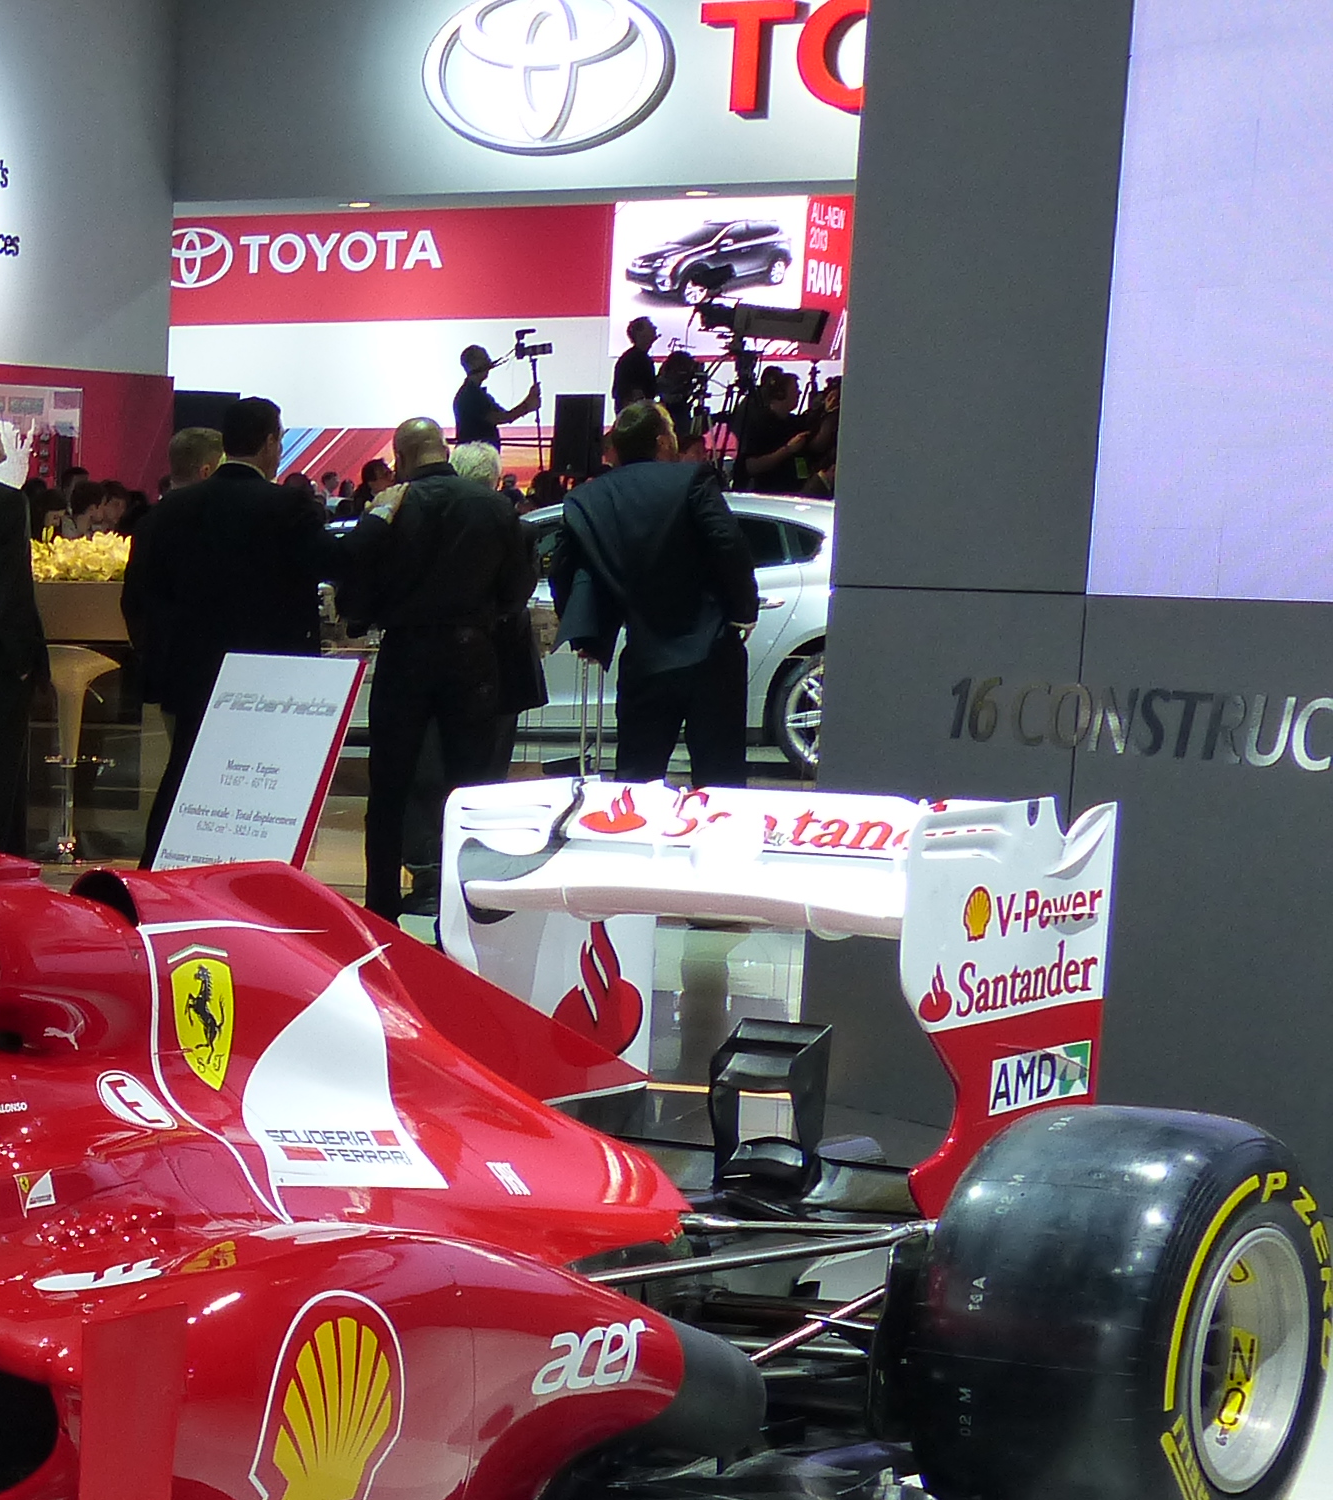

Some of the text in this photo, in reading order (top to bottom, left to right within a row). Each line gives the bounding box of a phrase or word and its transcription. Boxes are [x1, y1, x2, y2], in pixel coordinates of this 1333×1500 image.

[811, 202, 847, 229] ALL-NEW
[240, 230, 443, 274] TOYOTA
[806, 259, 844, 297] RAV4
[949, 677, 1003, 743] 16
[996, 889, 1103, 937] V-Power
[956, 939, 1098, 1017] Santander
[991, 1053, 1057, 1110] AMD
[265, 1130, 371, 1146] SCUDERIA
[324, 1148, 413, 1165] FERRARI
[1261, 1171, 1288, 1203] P
[532, 1318, 646, 1395] acer
